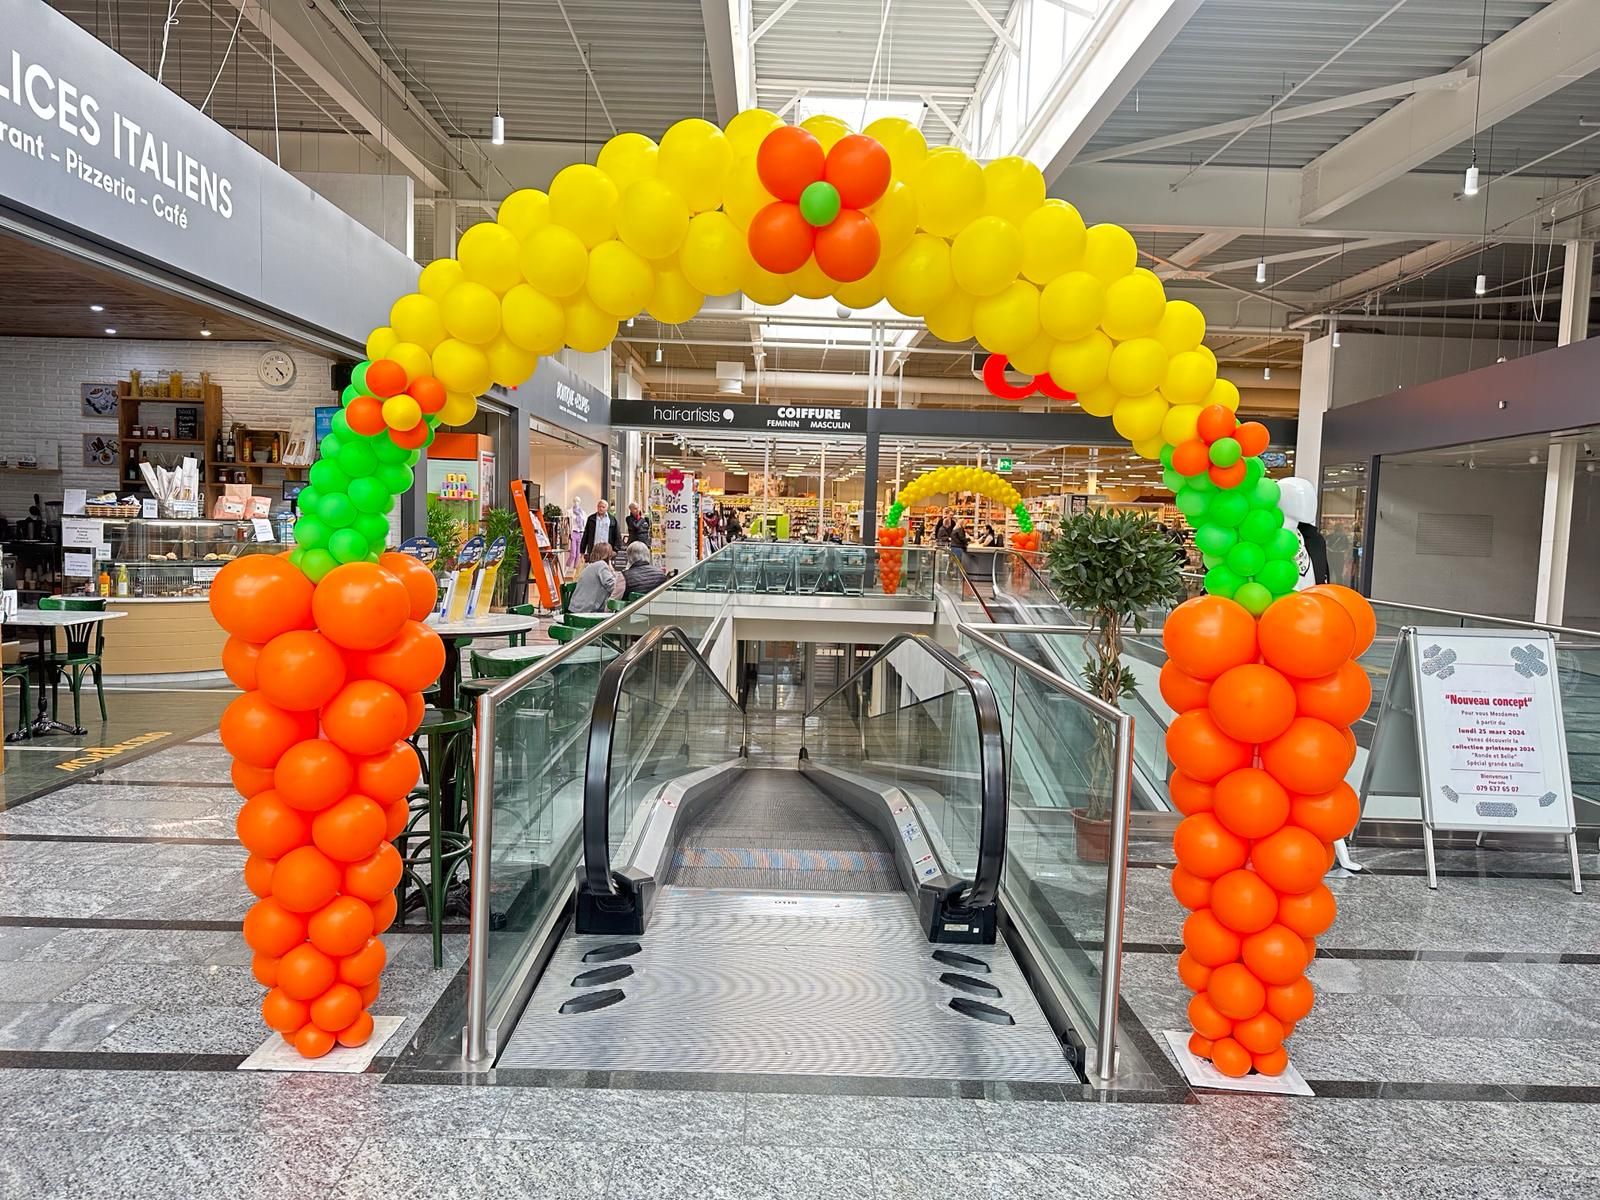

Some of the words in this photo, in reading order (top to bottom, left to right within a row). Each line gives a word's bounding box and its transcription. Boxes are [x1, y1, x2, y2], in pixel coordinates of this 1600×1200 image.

[66, 148, 135, 205] Pizzeria
[152, 194, 188, 229] Café
[113, 111, 233, 219] ITALIENS
[767, 419, 799, 428] FEMININ
[810, 420, 851, 430] MASCULIN
[777, 407, 841, 420] COIFFURE
